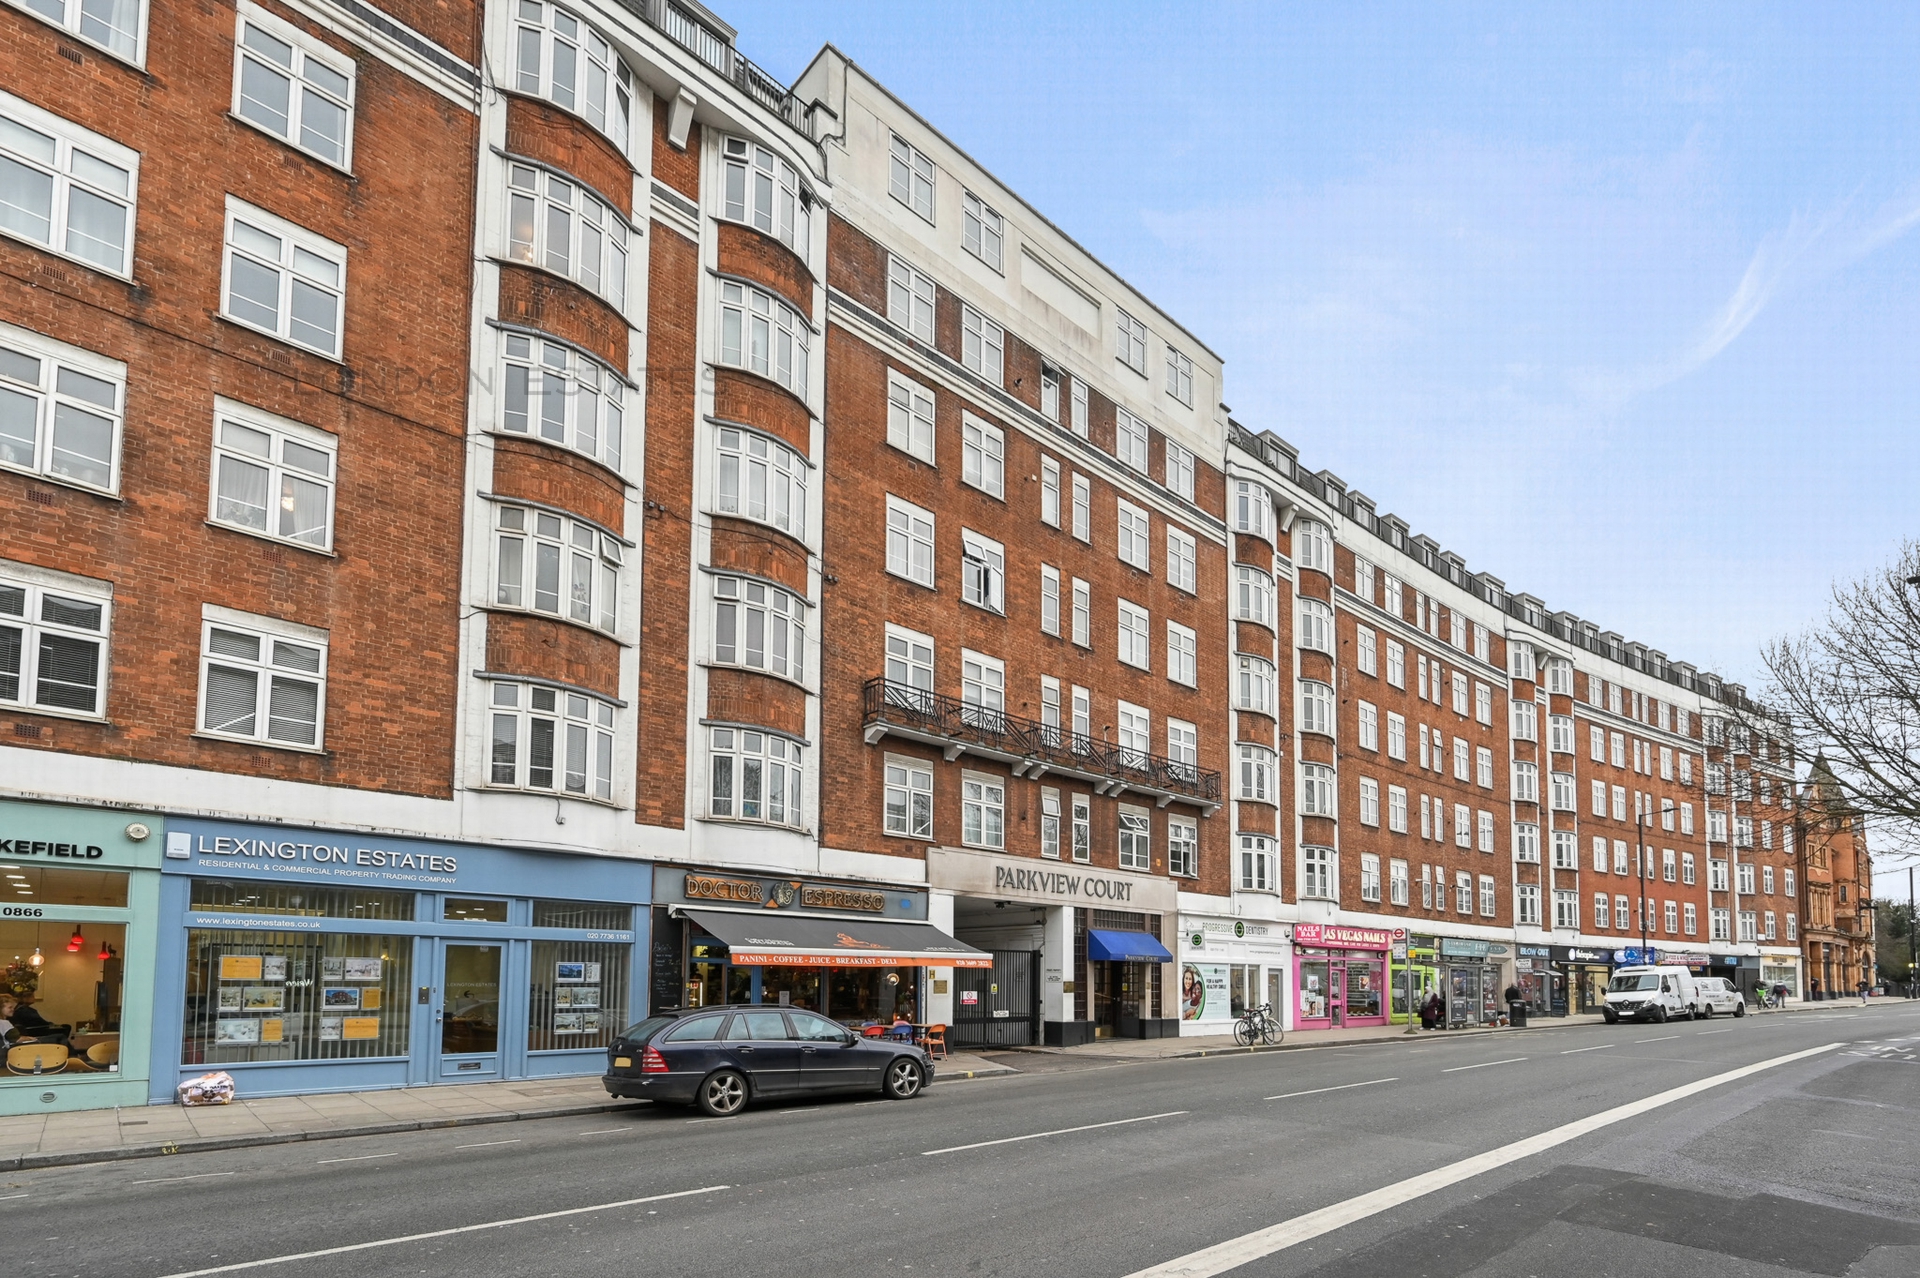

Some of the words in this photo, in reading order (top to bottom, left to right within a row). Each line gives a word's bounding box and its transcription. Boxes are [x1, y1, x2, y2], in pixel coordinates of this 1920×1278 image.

[198, 835, 349, 864] LEXINGTON
[356, 848, 457, 873] ESTATES
[198, 859, 261, 871] RESIDENTIAL
[272, 864, 332, 876] COMMERCIAL
[334, 869, 379, 879] PROPERTY
[381, 872, 417, 882] TRADING
[418, 875, 457, 885] COMPANY
[995, 866, 1081, 895] PARKVIEW
[1084, 877, 1133, 901] COURT
[687, 878, 764, 901] DOCTOR
[804, 889, 885, 910] ESPRESSO
[3, 907, 43, 917] 0866
[196, 917, 321, 928] www.lexingtonestates.co.uk
[1202, 922, 1233, 934] PROGRESSIVE
[1245, 925, 1269, 936] DENTISTRY
[1324, 929, 1336, 939] AS
[1336, 929, 1363, 942] VEGAS
[1363, 932, 1386, 943] NAILS
[1519, 947, 1537, 956] BLOW
[1537, 948, 1550, 957] OUT
[739, 954, 768, 964] PANINI
[773, 954, 804, 965] COFFEE
[809, 956, 831, 966] JUICE
[836, 957, 877, 967] BREAKFAST
